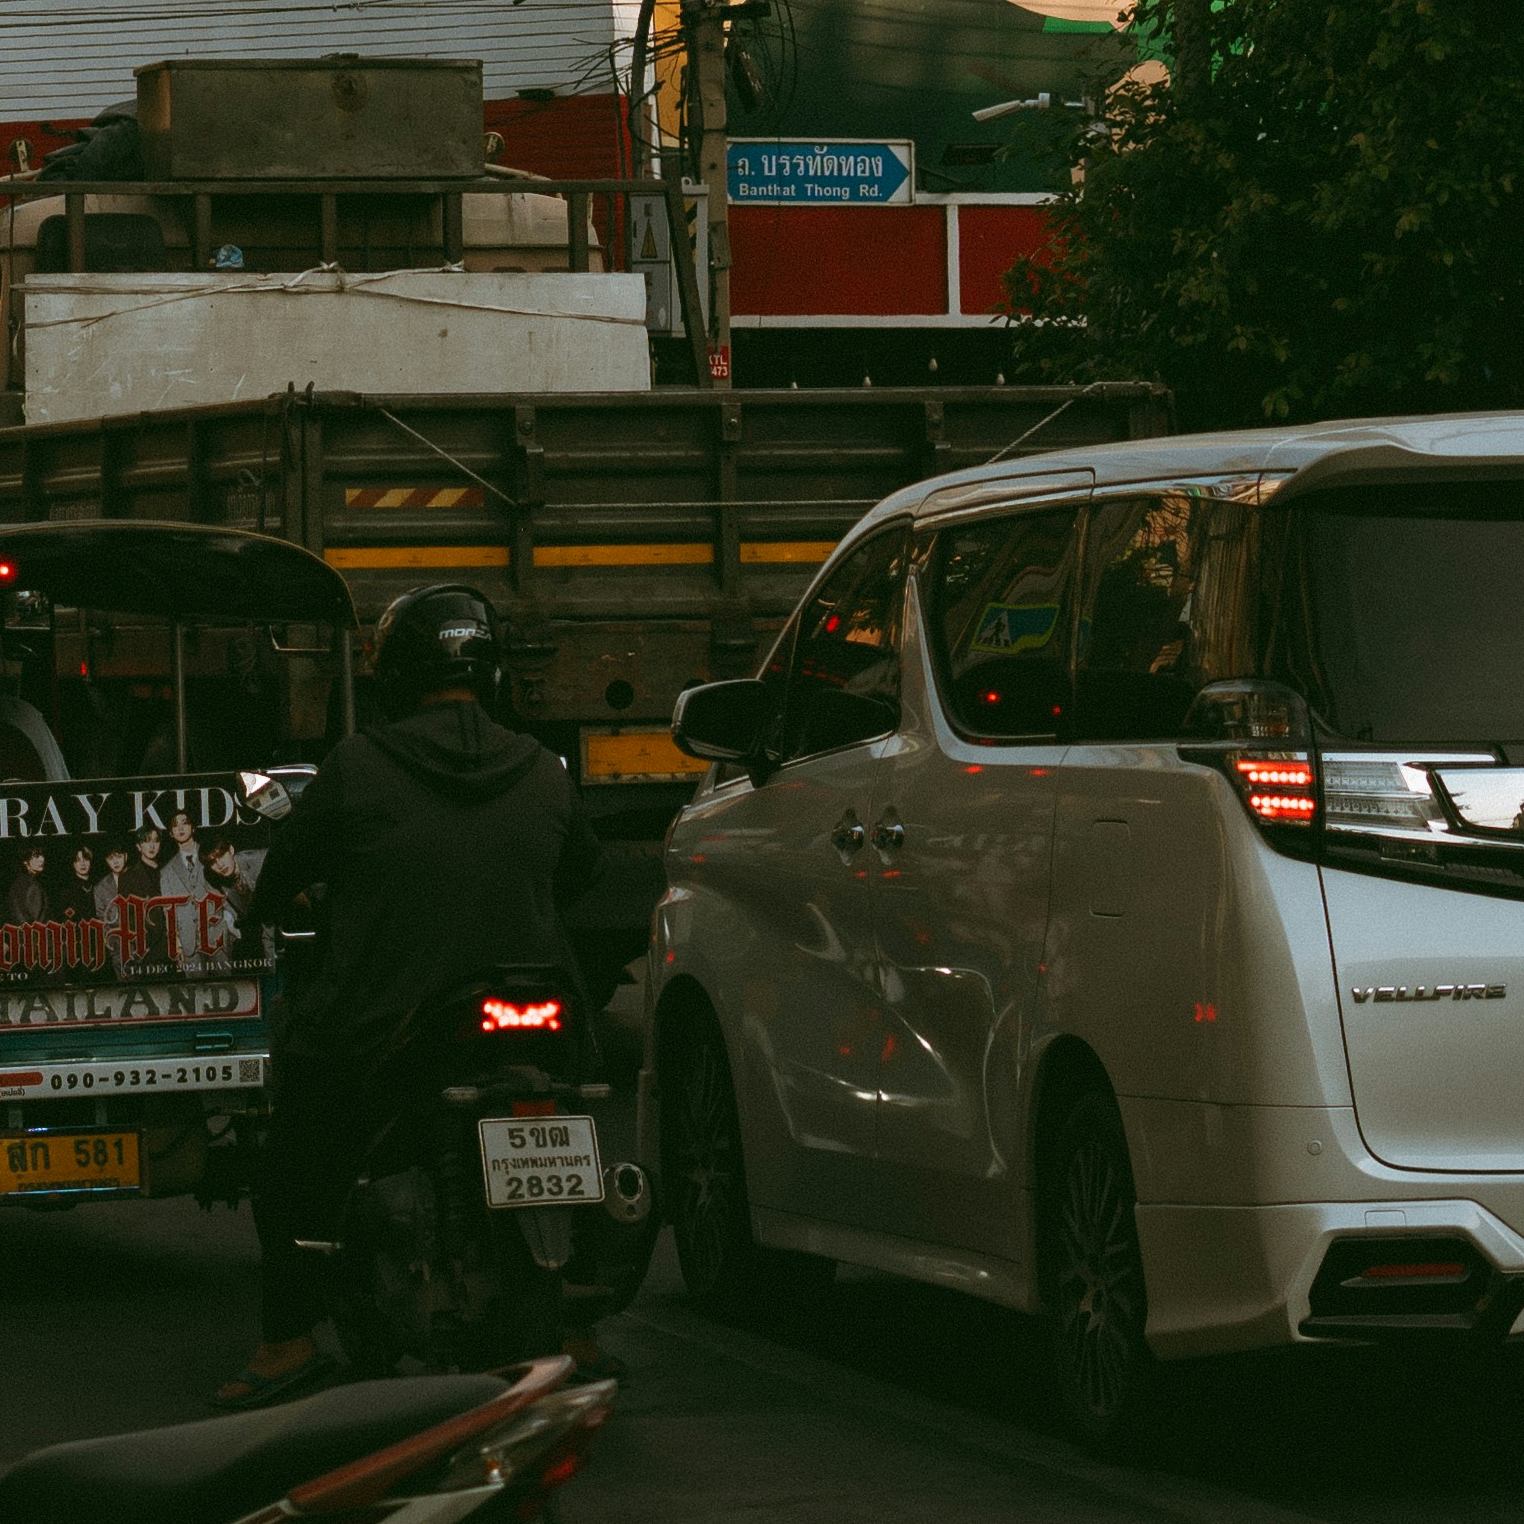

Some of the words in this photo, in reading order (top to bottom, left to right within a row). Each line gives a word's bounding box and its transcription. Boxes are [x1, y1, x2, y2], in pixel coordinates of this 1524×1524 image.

[737, 155, 756, 177] ถ.
[761, 146, 883, 178] บรรทัดทอง
[739, 183, 797, 198] Banthat
[805, 183, 850, 201] Thong
[860, 183, 883, 198] Rd.
[6, 972, 29, 982] TO
[1351, 982, 1508, 1004] VELLFIRE
[50, 1065, 233, 1091] 090-932-2105
[74, 1137, 125, 1169] 581
[491, 1154, 591, 1177] กรุงเทพมหานคร
[506, 1173, 585, 1199] 2832
